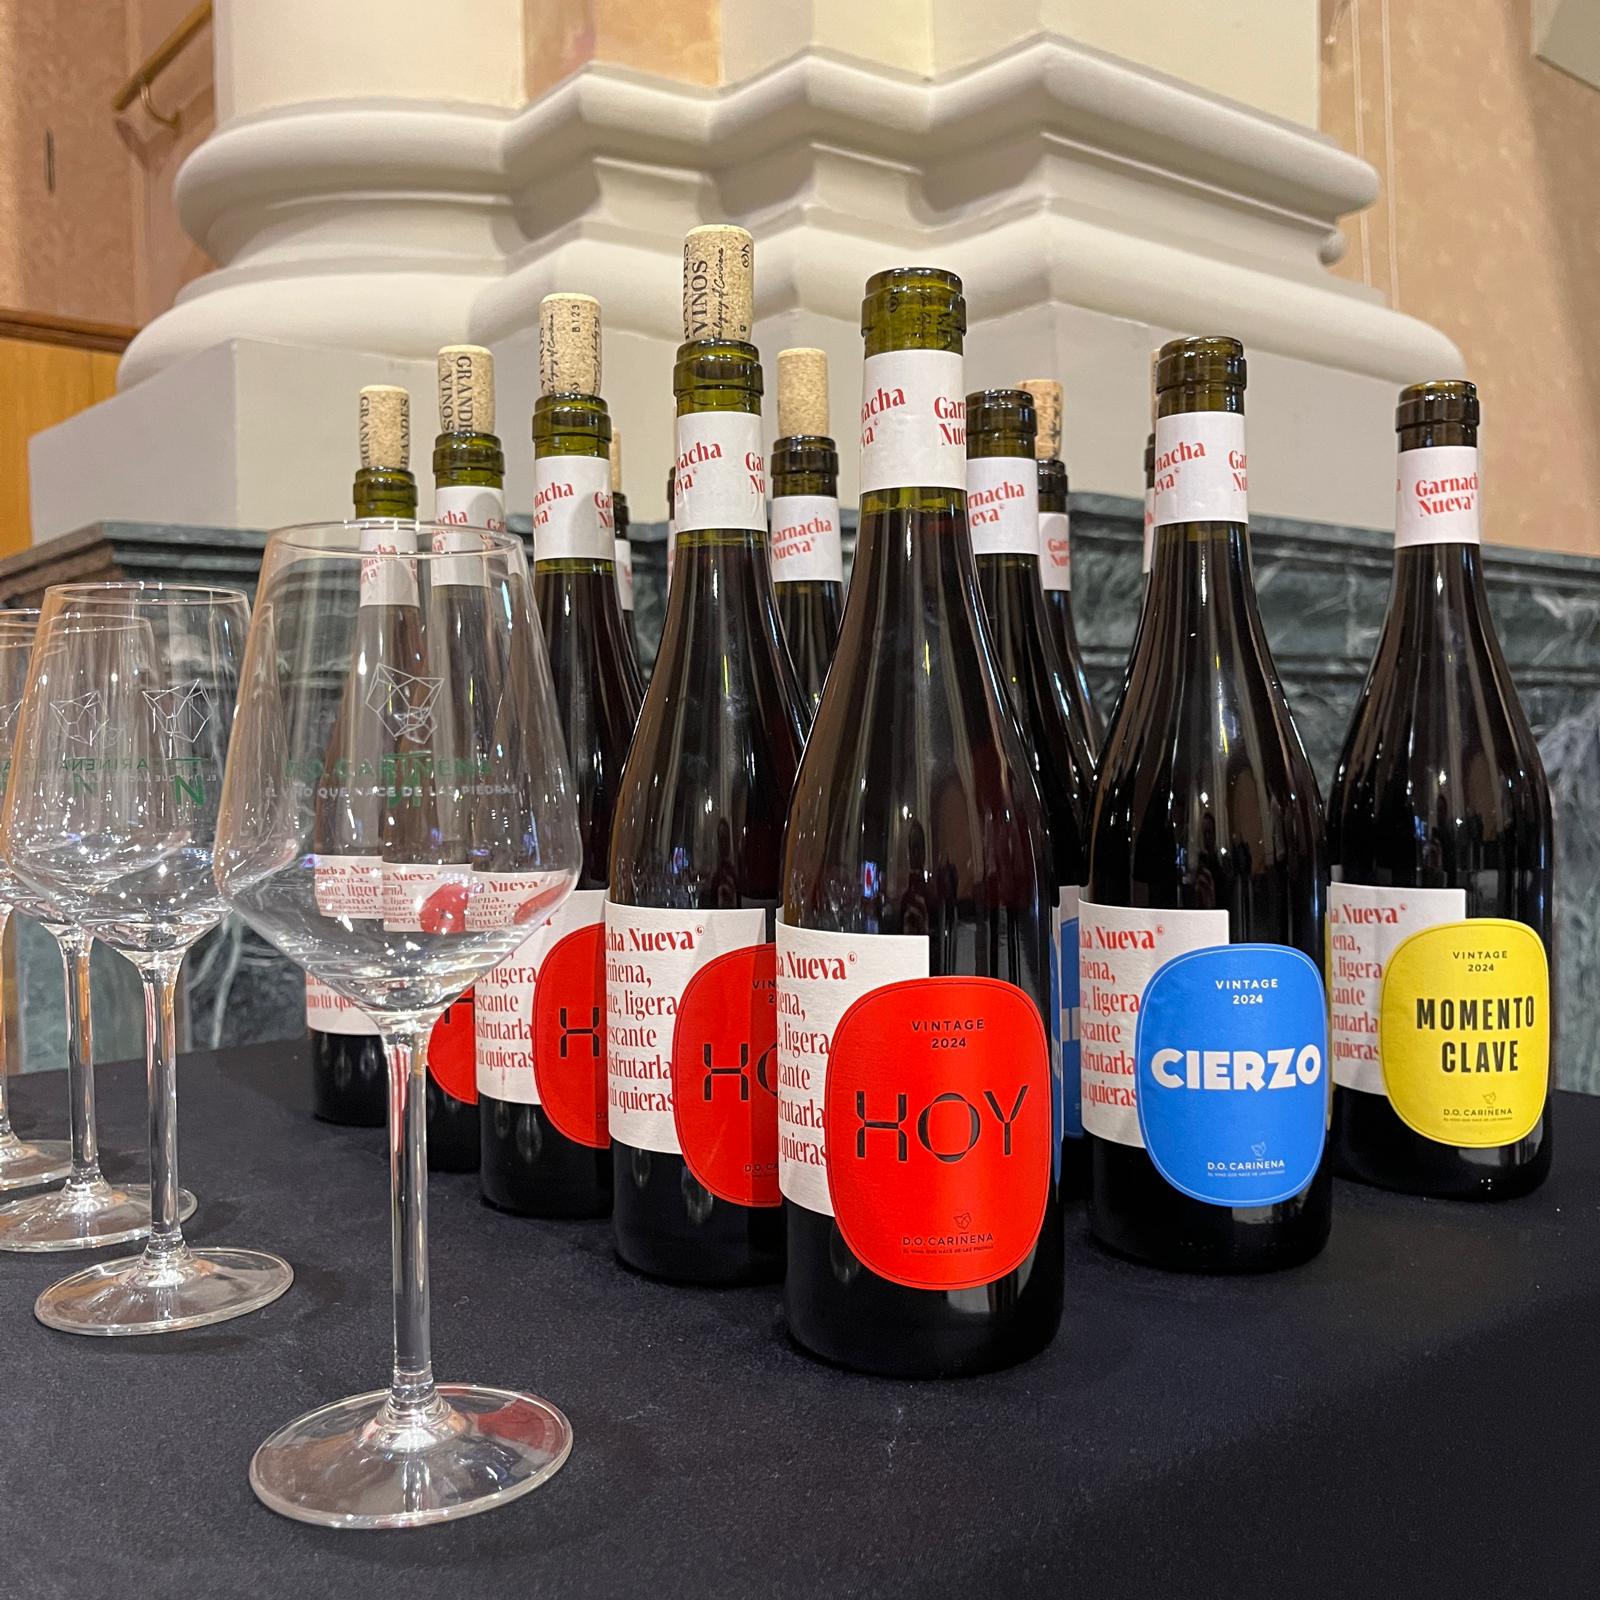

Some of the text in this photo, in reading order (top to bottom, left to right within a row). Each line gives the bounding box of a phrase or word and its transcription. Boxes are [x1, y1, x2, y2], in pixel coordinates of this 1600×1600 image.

[691, 260, 708, 337] VINOS
[441, 372, 455, 432] VINOS
[401, 786, 423, 798] DE
[1452, 950, 1509, 961] VINTAGE
[1467, 963, 1495, 973] 2024
[1215, 978, 1279, 990] VINTAGE
[1233, 994, 1264, 1005] 2024
[1415, 995, 1536, 1032] MOMENTO
[912, 1018, 985, 1032] VINTAGE
[931, 1037, 967, 1049] 2024
[1441, 1040, 1519, 1074] CLAVE
[1150, 1043, 1322, 1093] CIERZO
[856, 1084, 1029, 1163] HOY
